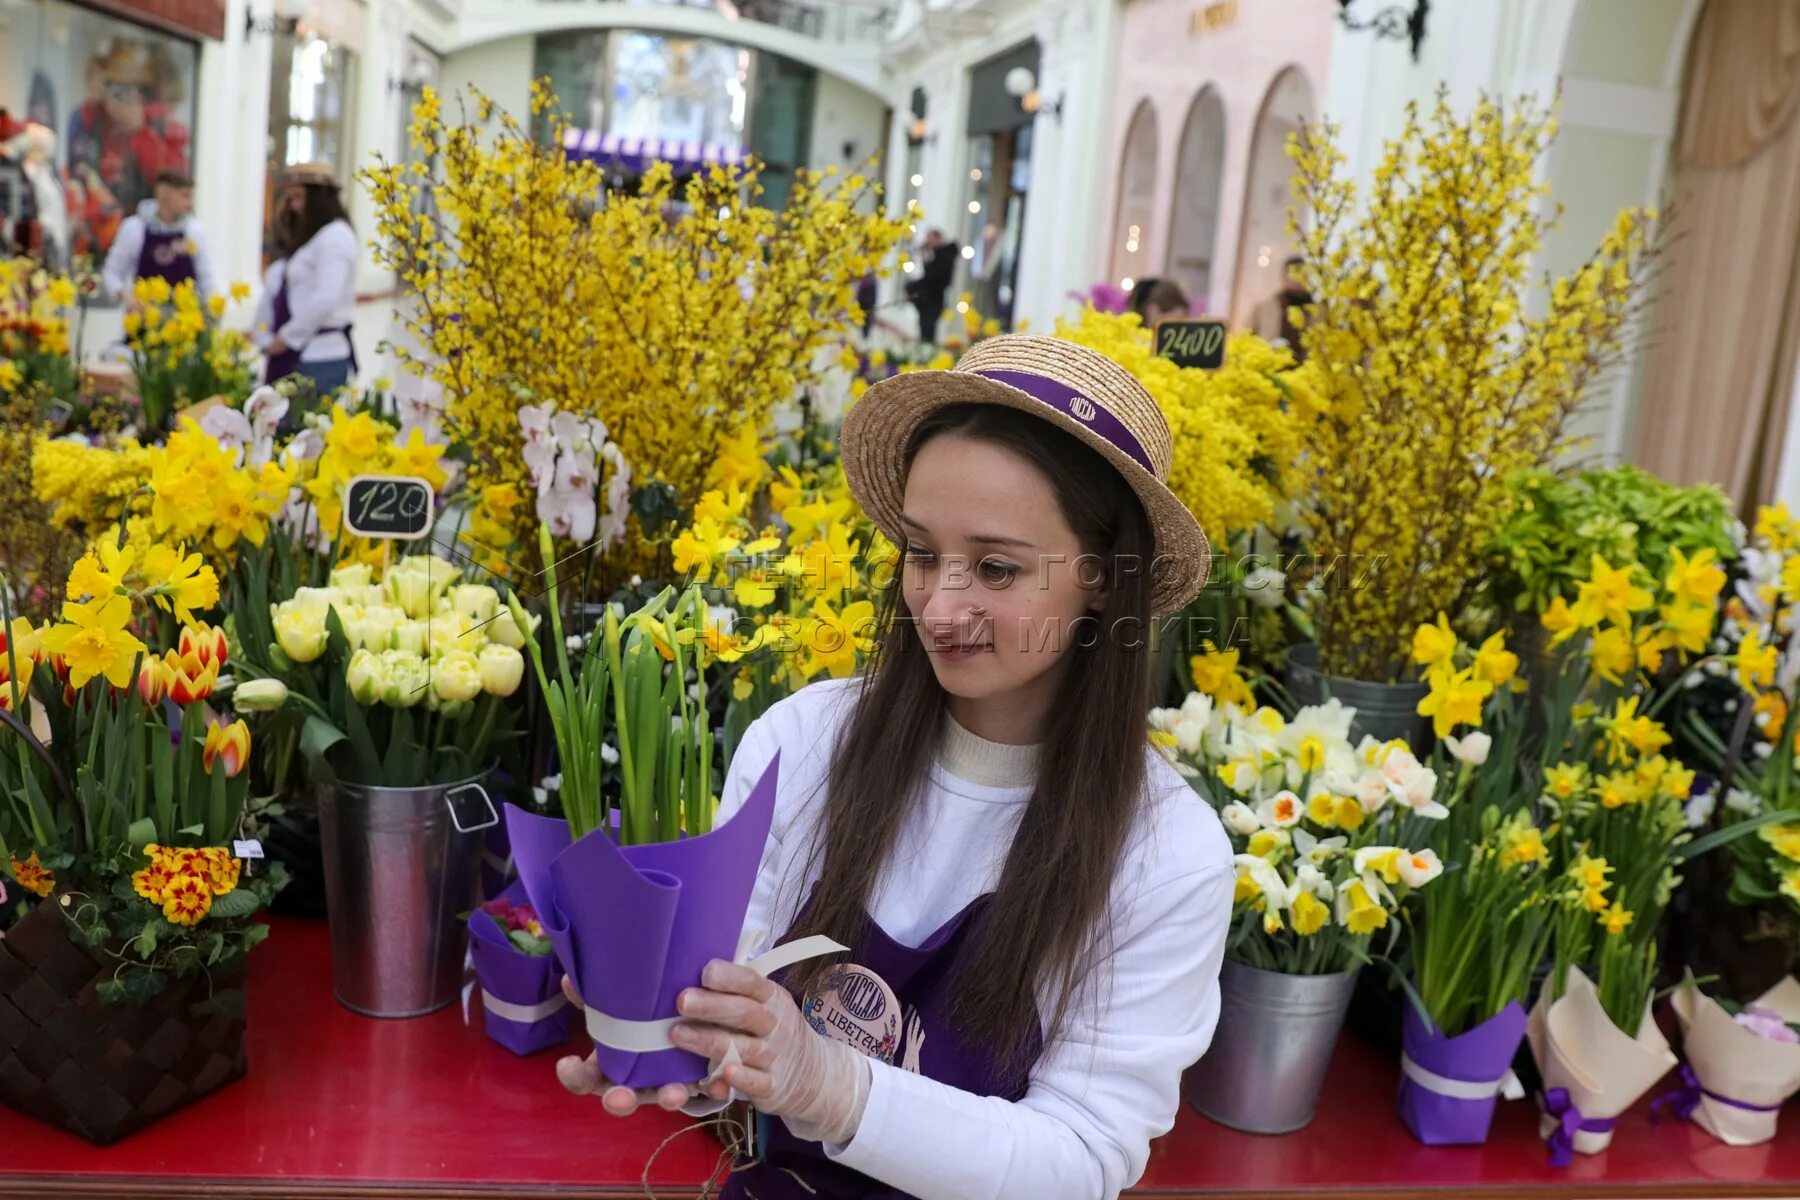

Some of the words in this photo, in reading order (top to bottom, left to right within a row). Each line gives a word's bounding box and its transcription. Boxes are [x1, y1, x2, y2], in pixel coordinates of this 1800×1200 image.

[1160, 325, 1223, 357] 2400
[356, 482, 426, 524] 120
[813, 997, 824, 1013] В
[826, 1008, 881, 1055] ЦВЕТАХ
